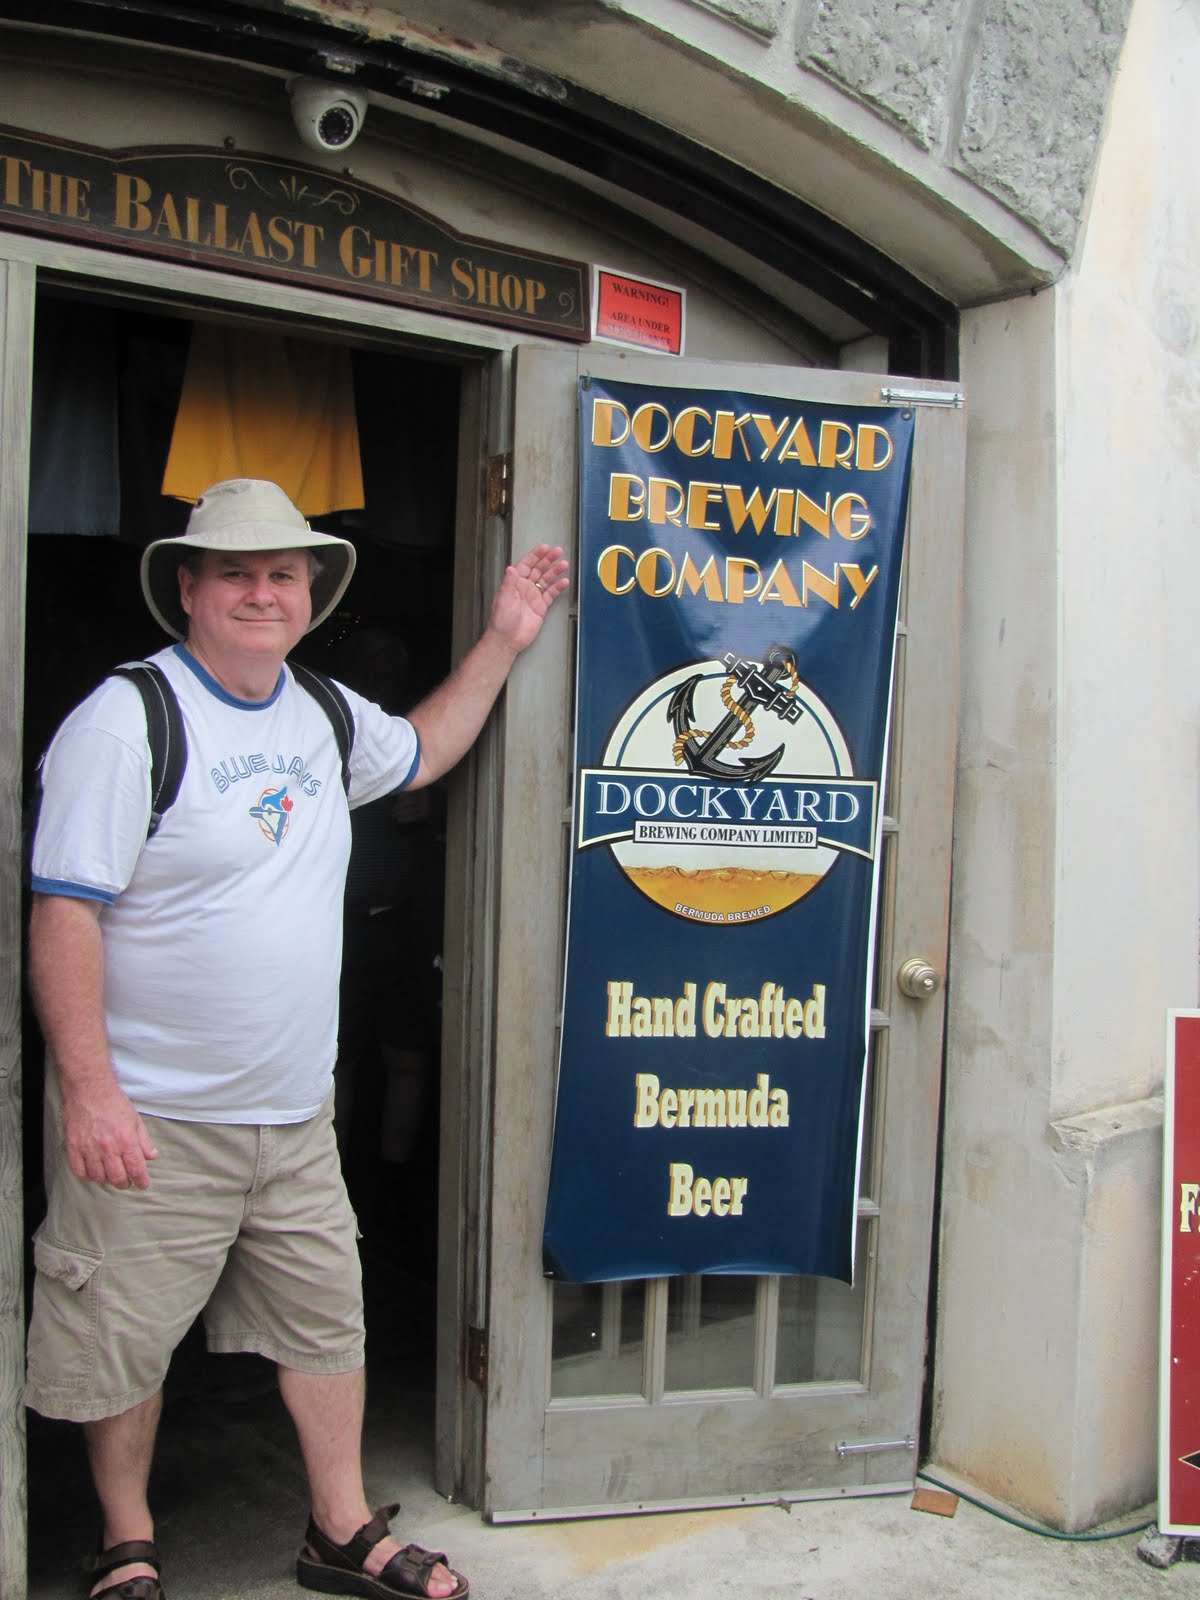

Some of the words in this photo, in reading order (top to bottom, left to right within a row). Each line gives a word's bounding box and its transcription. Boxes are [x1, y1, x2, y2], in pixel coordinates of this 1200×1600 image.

[0, 155, 91, 222] THE
[112, 172, 325, 269] BALLAST
[338, 224, 439, 293] GIFT
[451, 256, 546, 315] SHOP
[612, 283, 669, 307] WARNING!
[611, 312, 636, 325] AREA
[638, 317, 670, 333] UNDER
[591, 398, 894, 471] DOCKYARD
[608, 472, 872, 540] BREWING
[597, 544, 879, 609] COMPANY
[210, 753, 270, 794] BLUE
[595, 781, 860, 823] DOCKYARD
[638, 825, 698, 841] BREWING
[700, 827, 760, 843] COMPANY
[762, 830, 814, 844] LIMITED
[674, 903, 725, 921] BERMUDA
[727, 905, 771, 921] BREWED
[605, 981, 697, 1037] Hand
[702, 981, 826, 1038] Crafted
[634, 1073, 790, 1128] Bermuda
[667, 1163, 748, 1217] Beer
